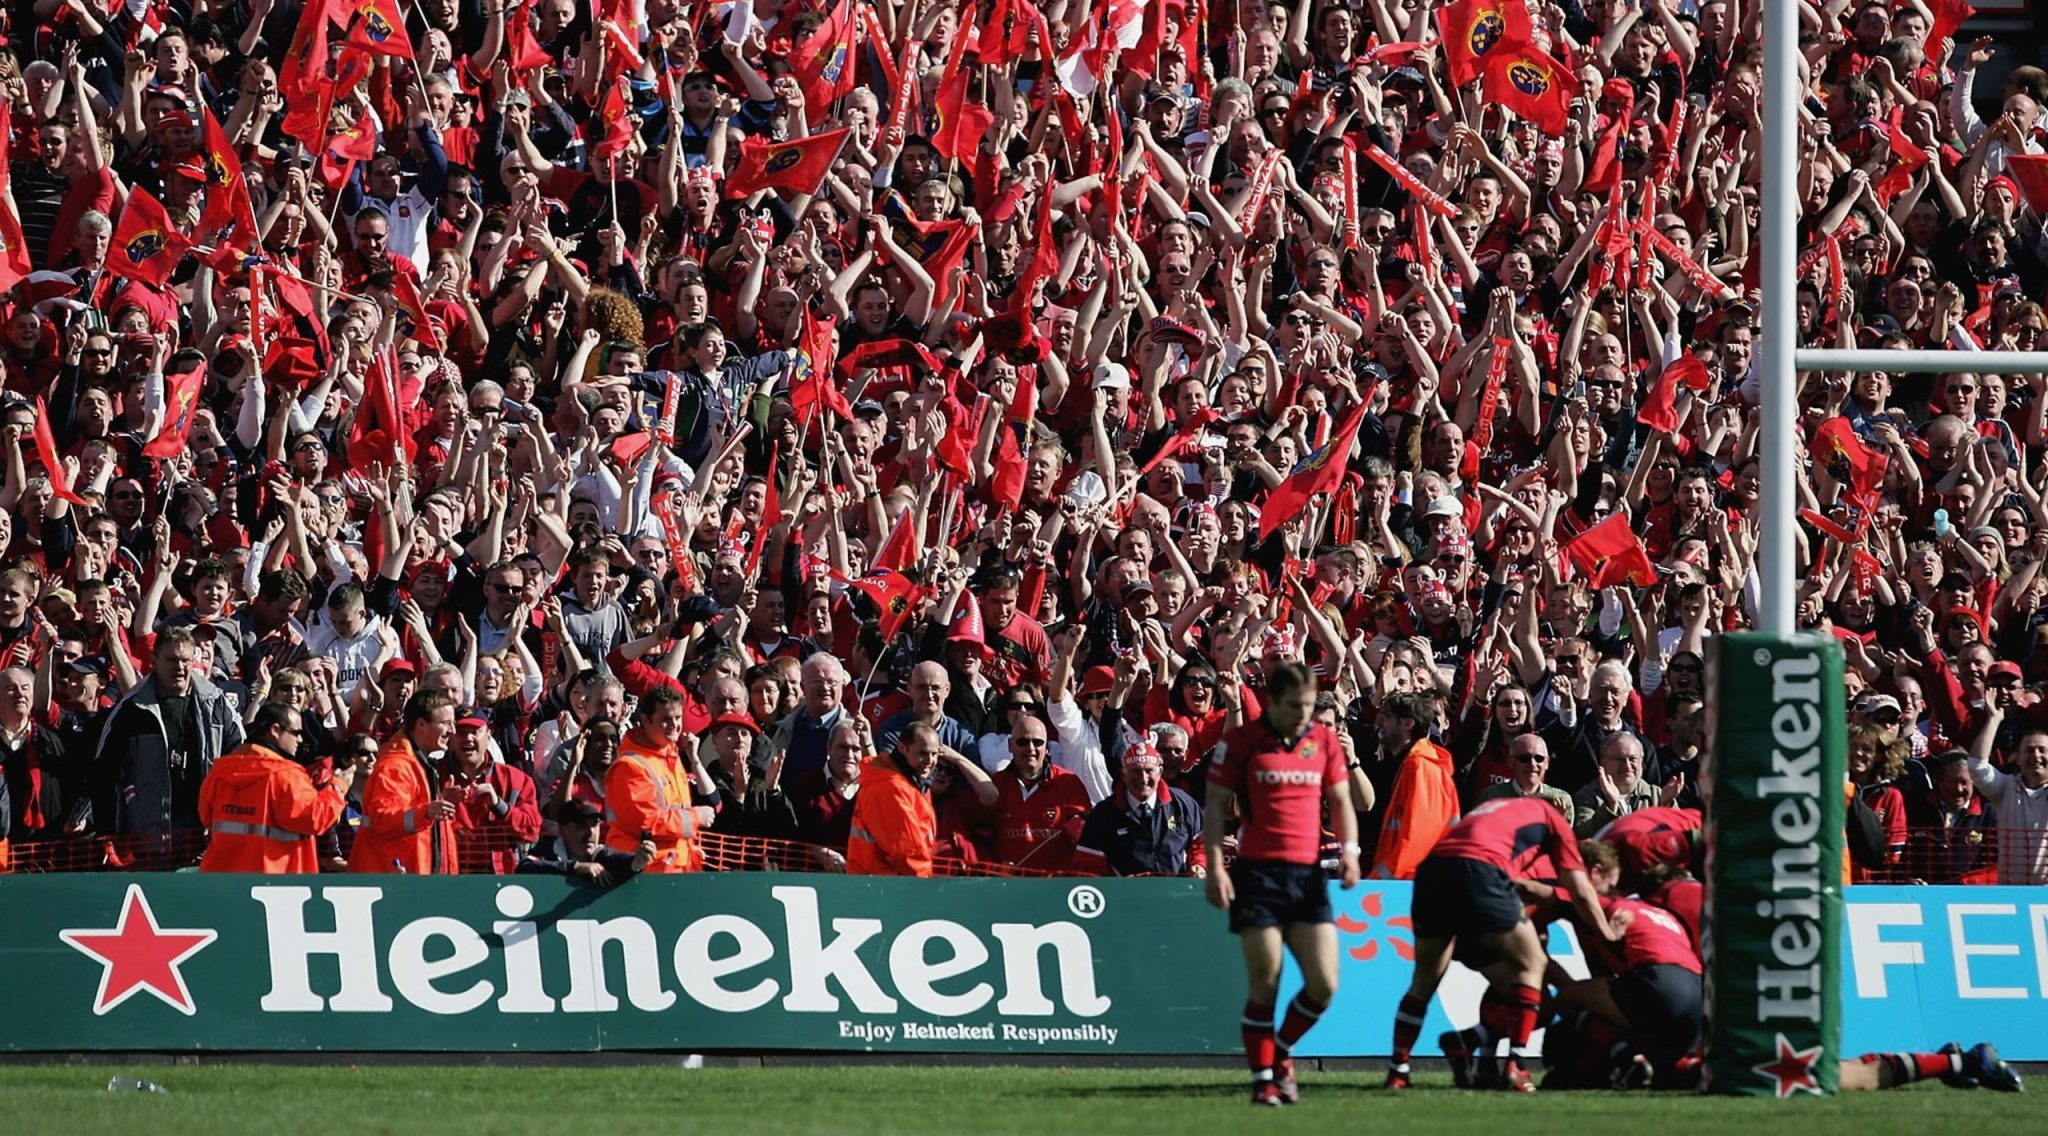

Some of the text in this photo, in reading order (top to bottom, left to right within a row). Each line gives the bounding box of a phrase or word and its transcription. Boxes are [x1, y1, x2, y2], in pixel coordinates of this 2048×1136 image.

[1475, 345, 1508, 444] MUNSTER
[657, 498, 695, 587] MUNSTE
[1136, 742, 1147, 755] 3
[1256, 770, 1321, 785] TOYOTA
[1757, 653, 1821, 1023] Heineken
[251, 885, 1111, 1017] Heineken
[839, 1021, 1118, 1044] Enjoy Heineken Responsibly
